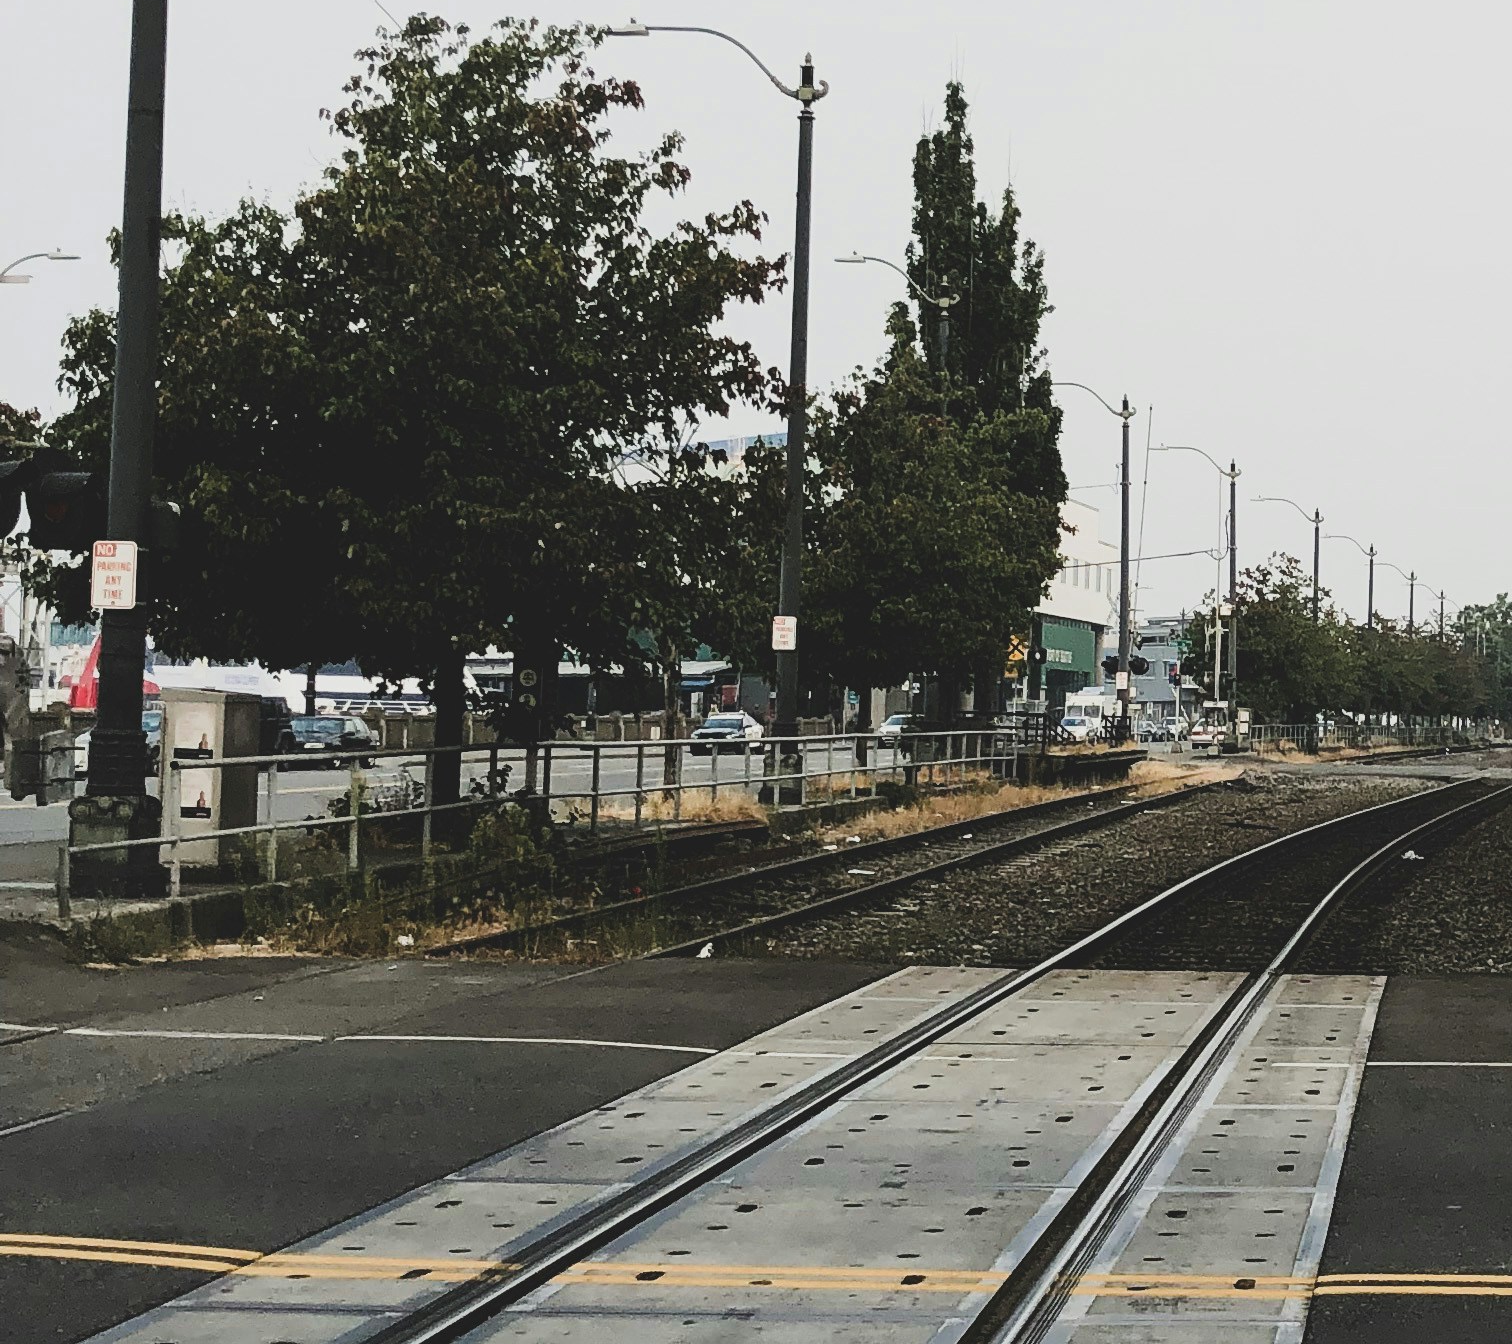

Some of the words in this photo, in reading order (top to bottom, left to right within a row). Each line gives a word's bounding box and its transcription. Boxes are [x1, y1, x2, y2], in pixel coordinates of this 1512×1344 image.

[97, 544, 114, 555] NO
[97, 562, 131, 572] PARKING
[105, 576, 122, 585] ANY
[103, 589, 123, 599] TIME
